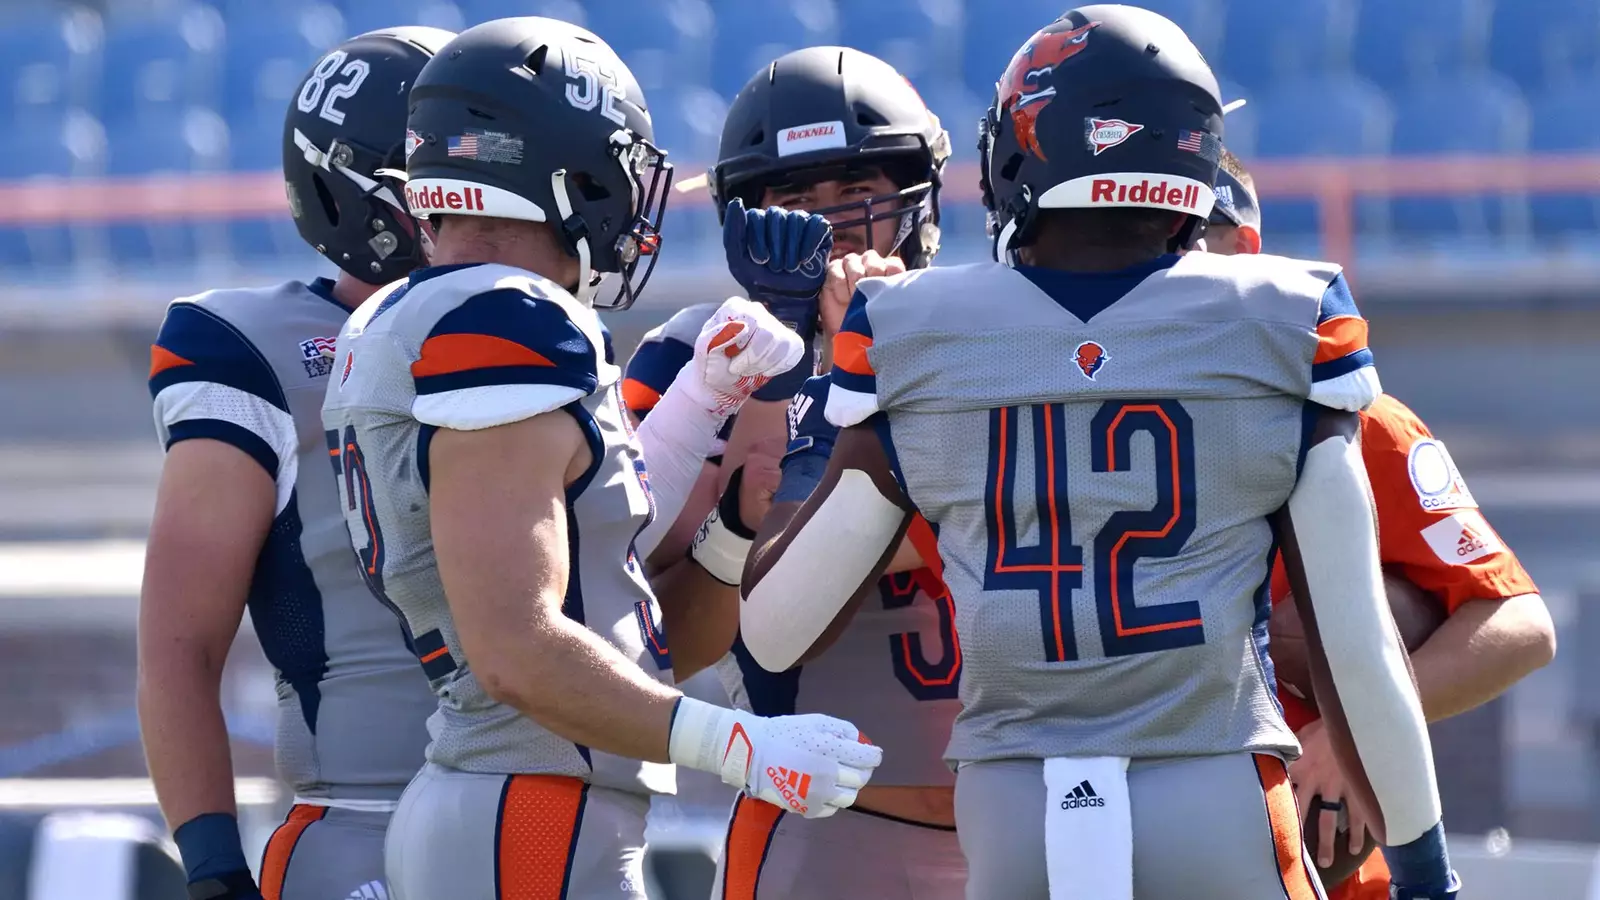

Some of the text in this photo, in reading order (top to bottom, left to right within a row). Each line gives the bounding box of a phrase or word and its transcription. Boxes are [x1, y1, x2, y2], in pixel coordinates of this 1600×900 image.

[296, 49, 371, 126] 82
[560, 47, 627, 127] 52
[786, 125, 836, 142] BUCKNELL
[405, 185, 484, 211] Riddell
[1091, 179, 1200, 209] Riddell
[982, 398, 1206, 663] 42
[766, 766, 809, 814] adidas
[1060, 796, 1105, 810] adidas
